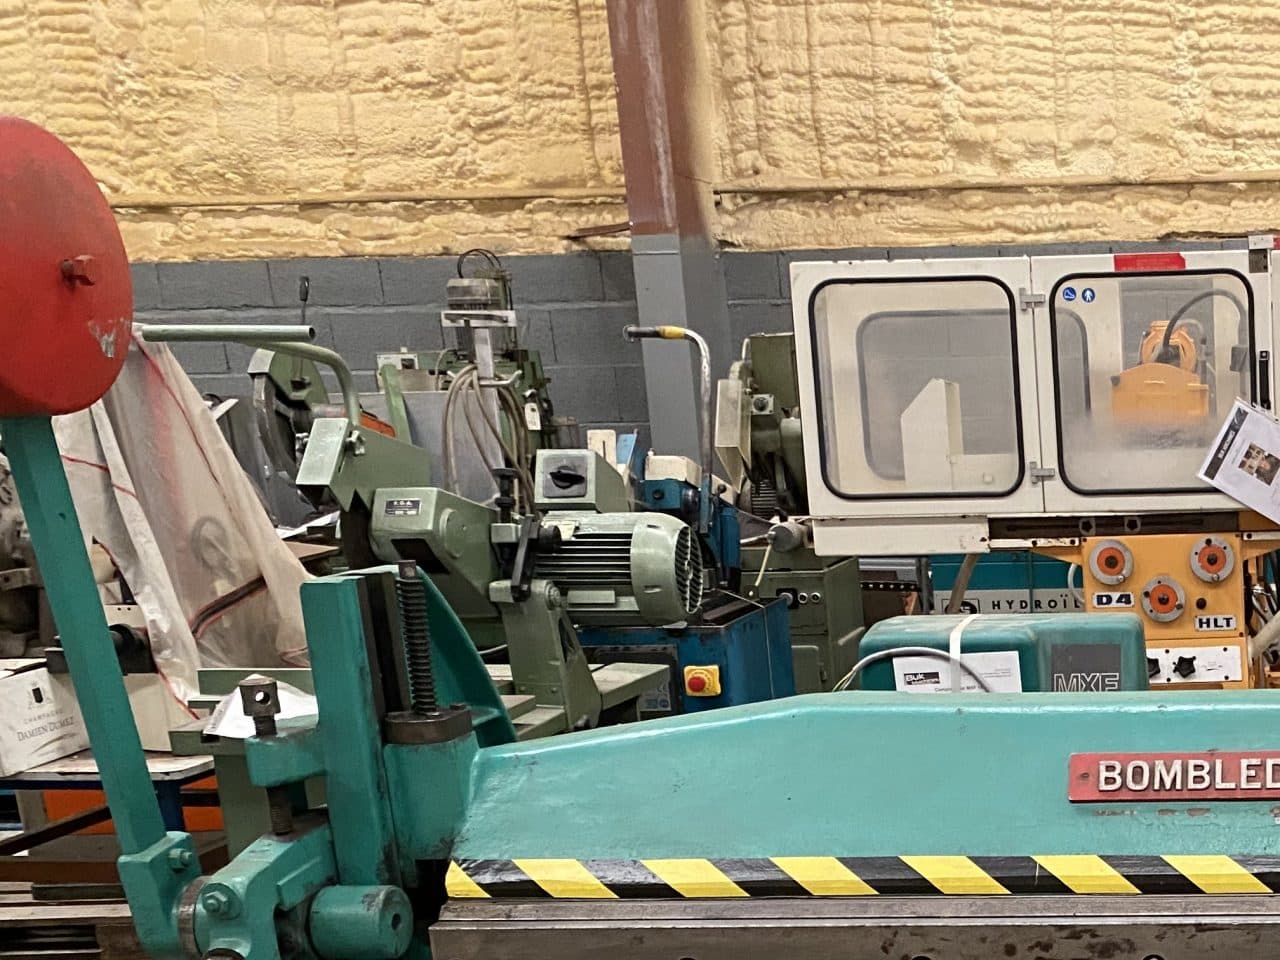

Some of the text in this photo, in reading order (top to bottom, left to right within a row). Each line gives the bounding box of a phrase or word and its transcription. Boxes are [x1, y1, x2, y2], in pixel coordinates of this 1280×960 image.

[992, 594, 1080, 610] HYDROÏL
[1096, 594, 1131, 605] D4
[1198, 617, 1233, 628] HLT
